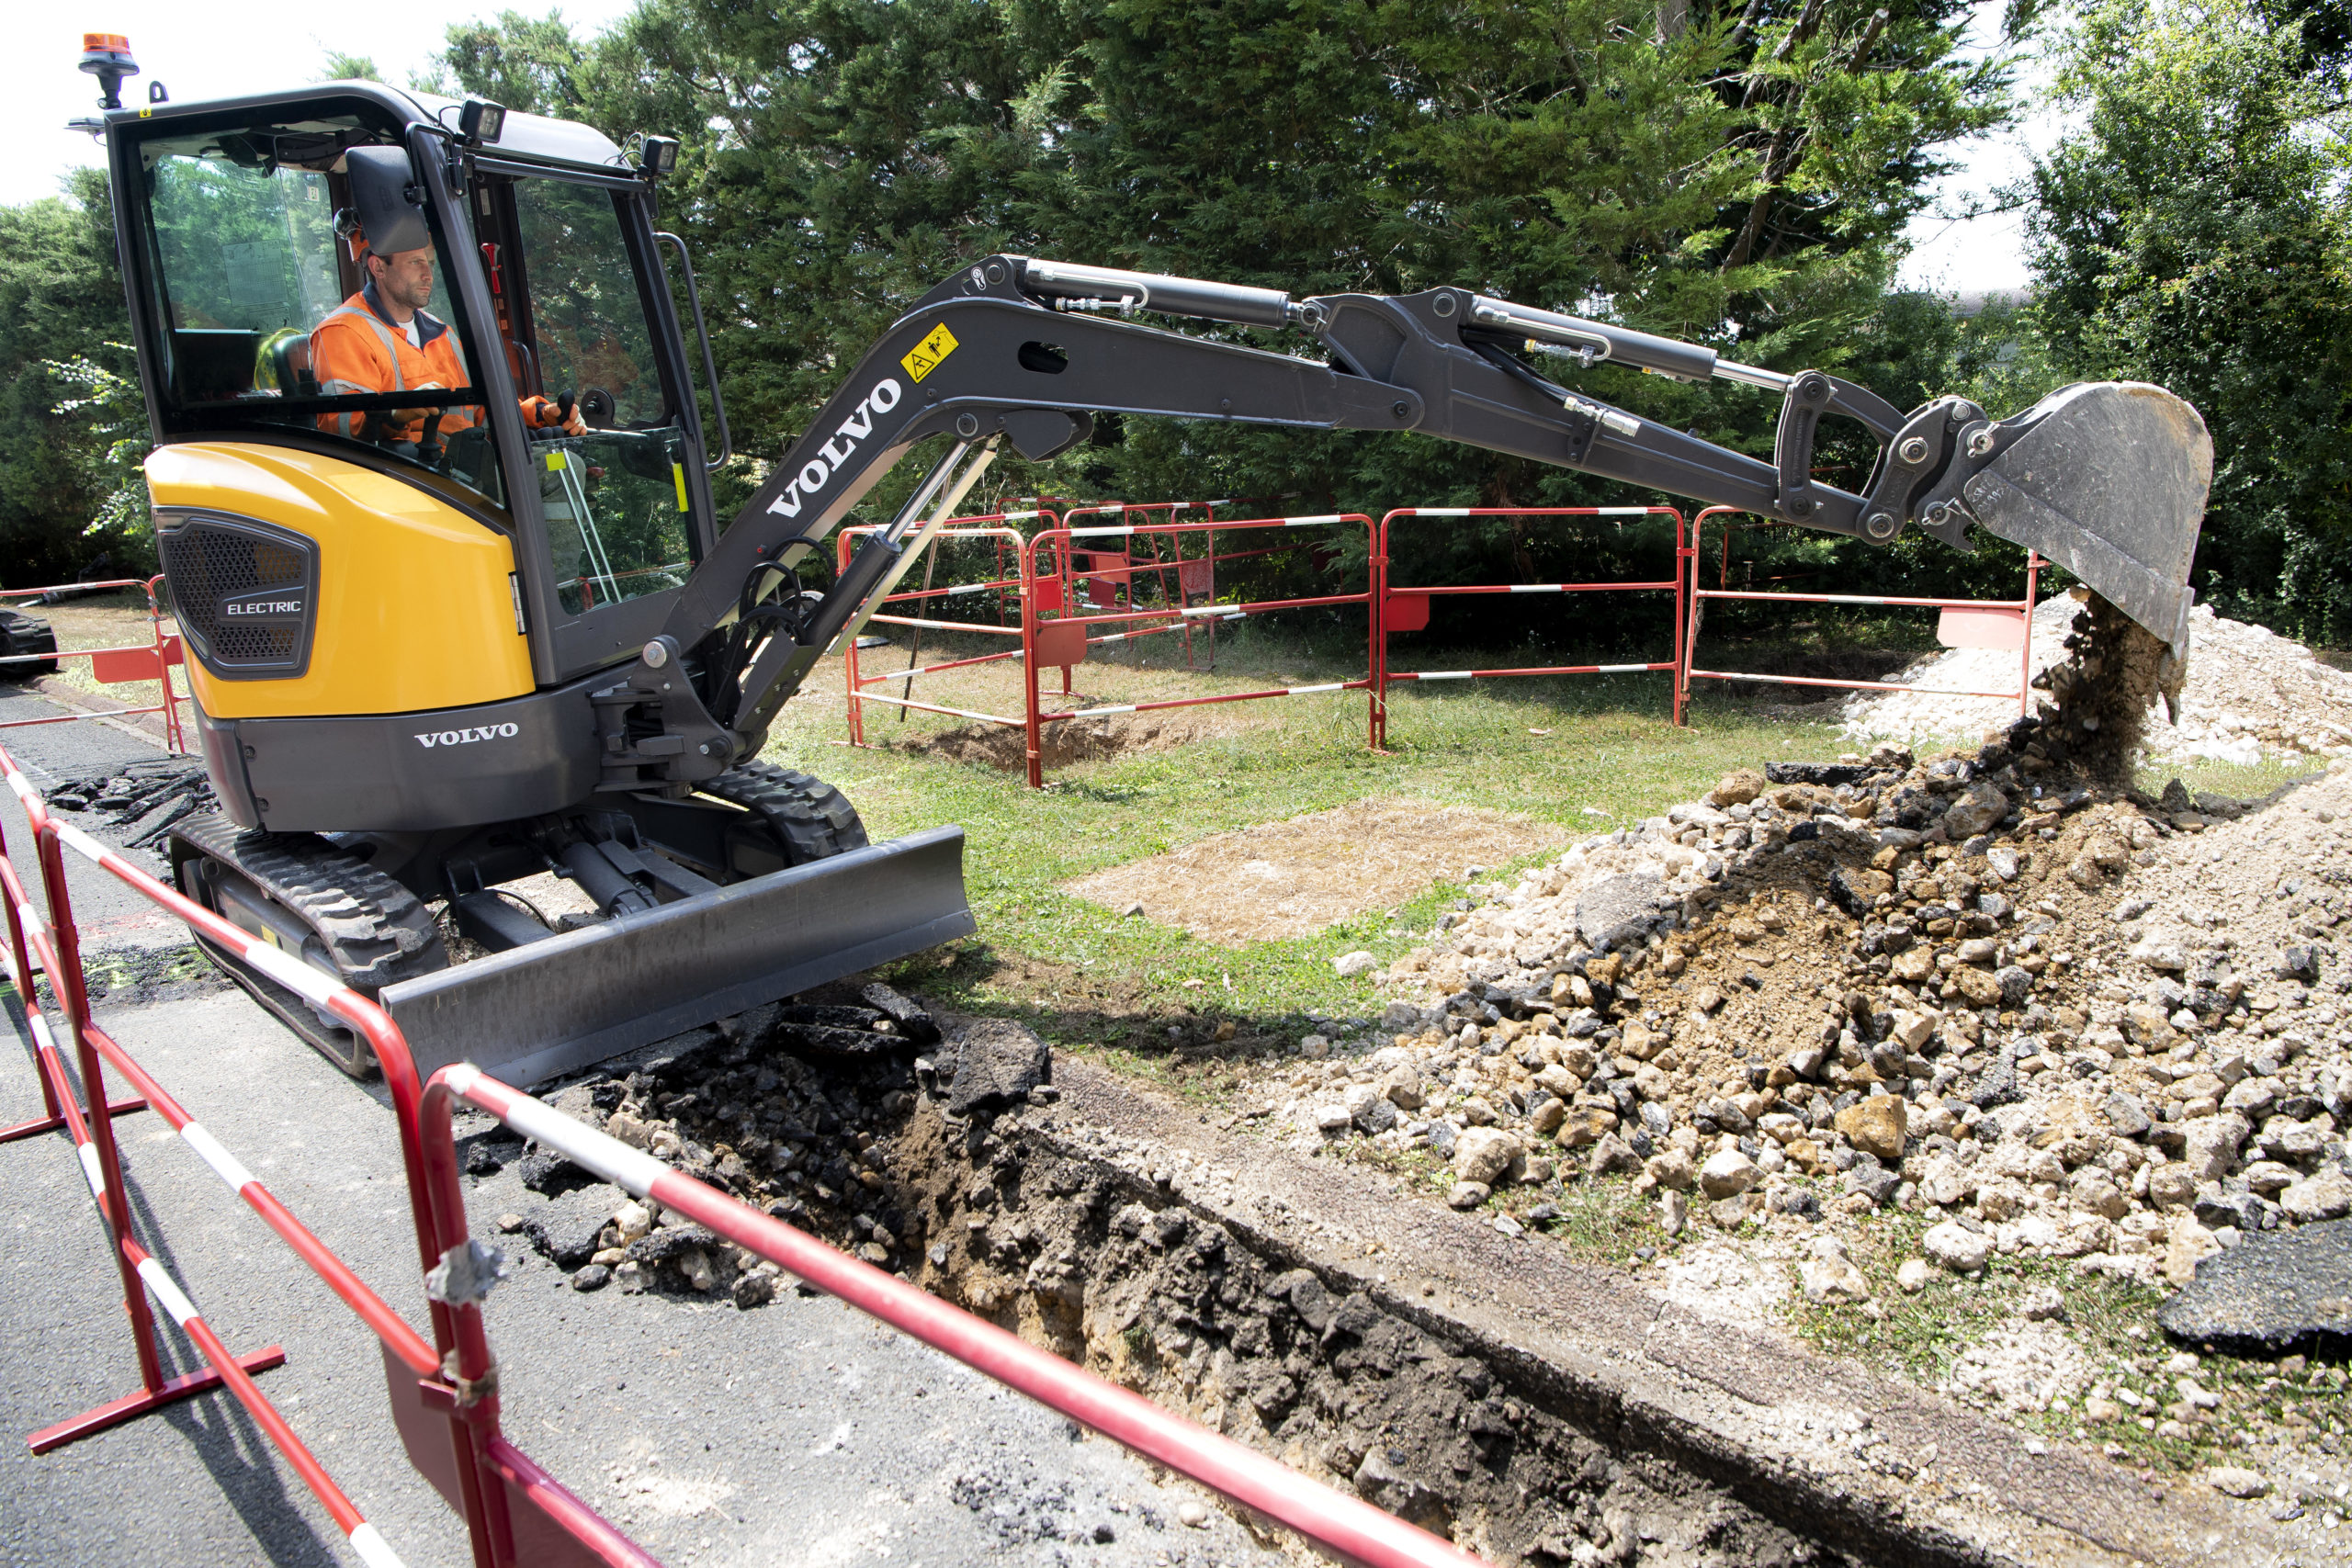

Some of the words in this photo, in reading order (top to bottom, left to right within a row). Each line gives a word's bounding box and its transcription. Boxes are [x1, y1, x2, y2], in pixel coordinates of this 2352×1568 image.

[766, 378, 901, 518] VOLVO
[227, 601, 301, 615] ELECTRIC
[413, 722, 519, 748] VOLVO
